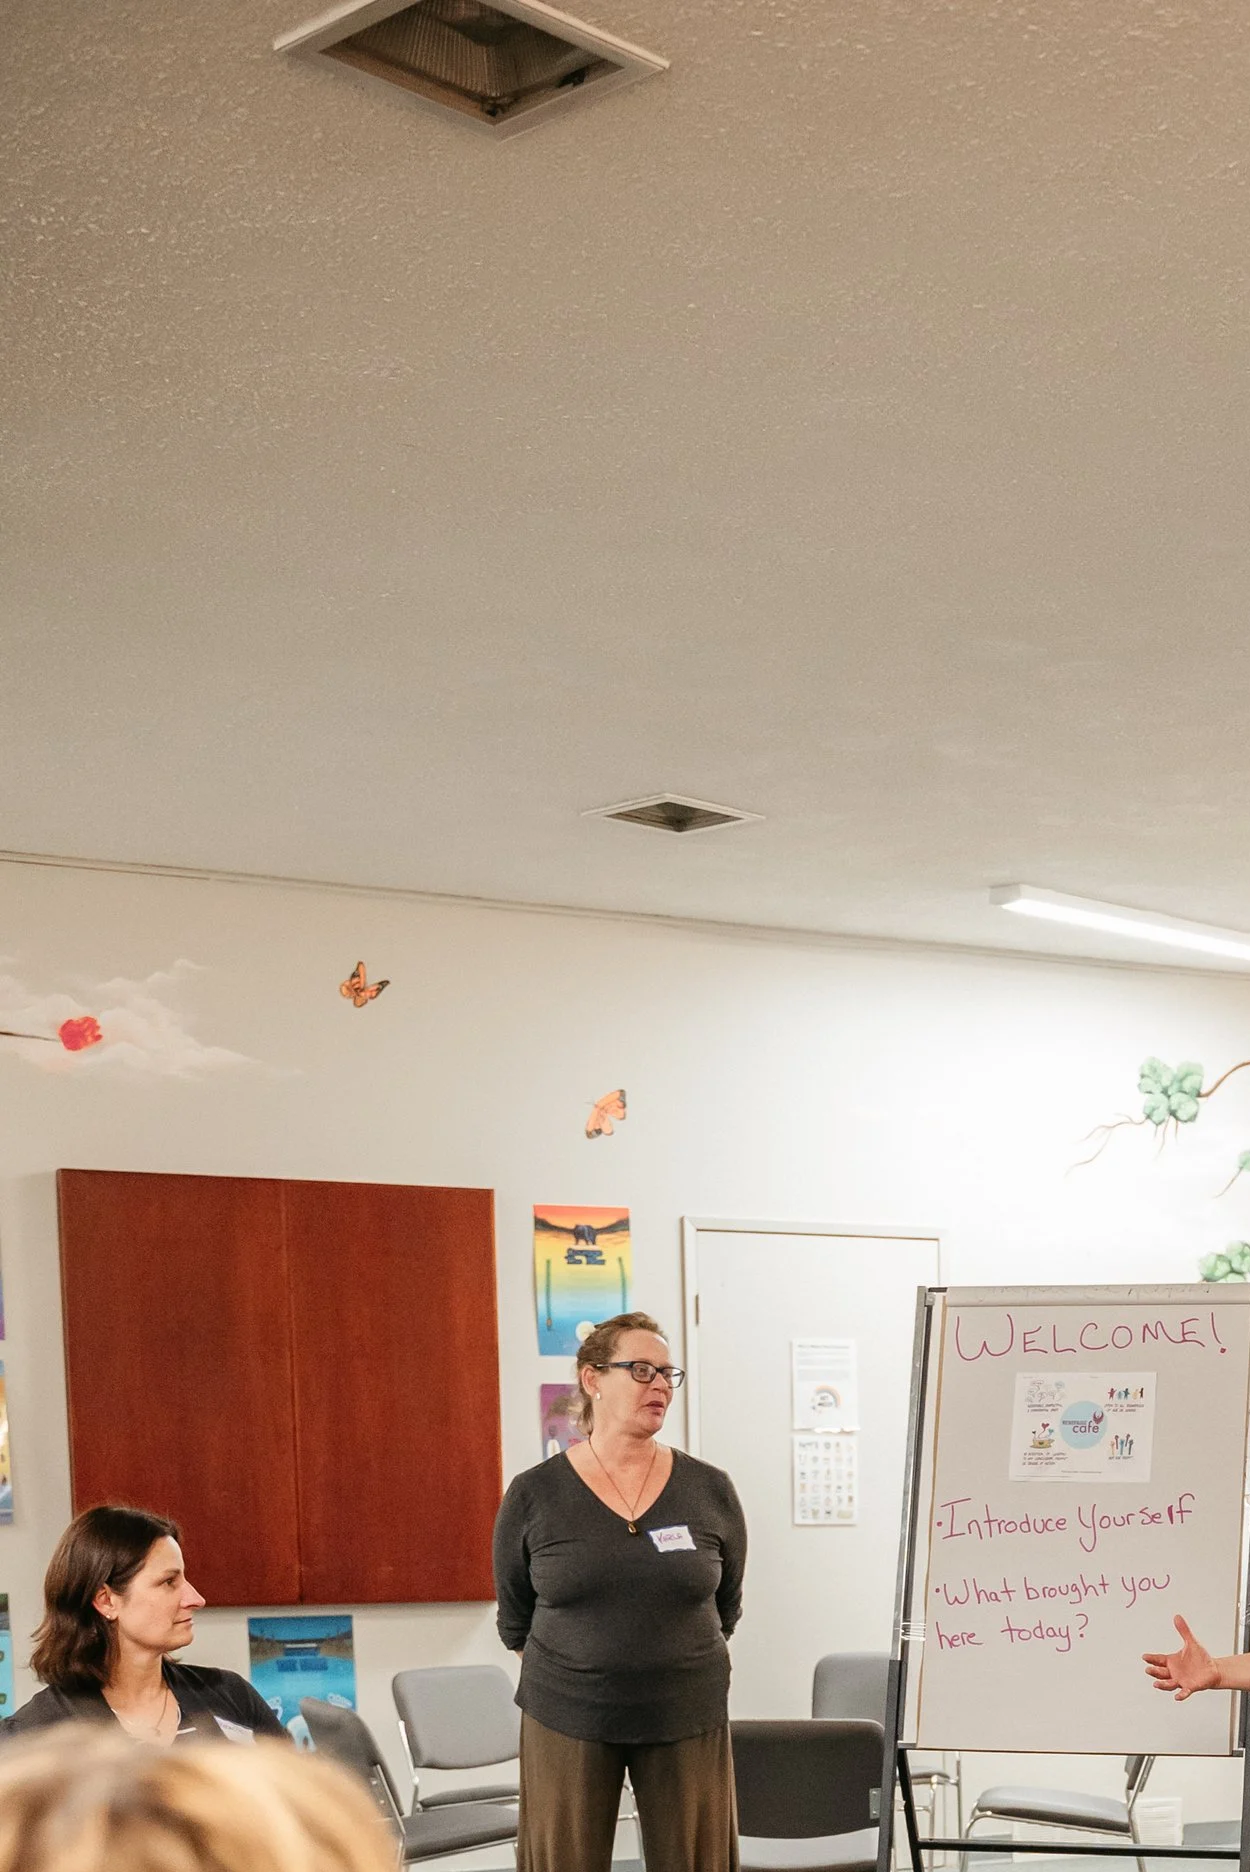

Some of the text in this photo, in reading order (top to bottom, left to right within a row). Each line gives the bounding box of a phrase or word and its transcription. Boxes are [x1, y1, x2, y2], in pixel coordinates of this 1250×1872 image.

[955, 1311, 1227, 1362] WELCOME!
[940, 1492, 1196, 1553] Introduce Yourself
[943, 1573, 1171, 1609] What brought you
[935, 1612, 1089, 1653] here today?
